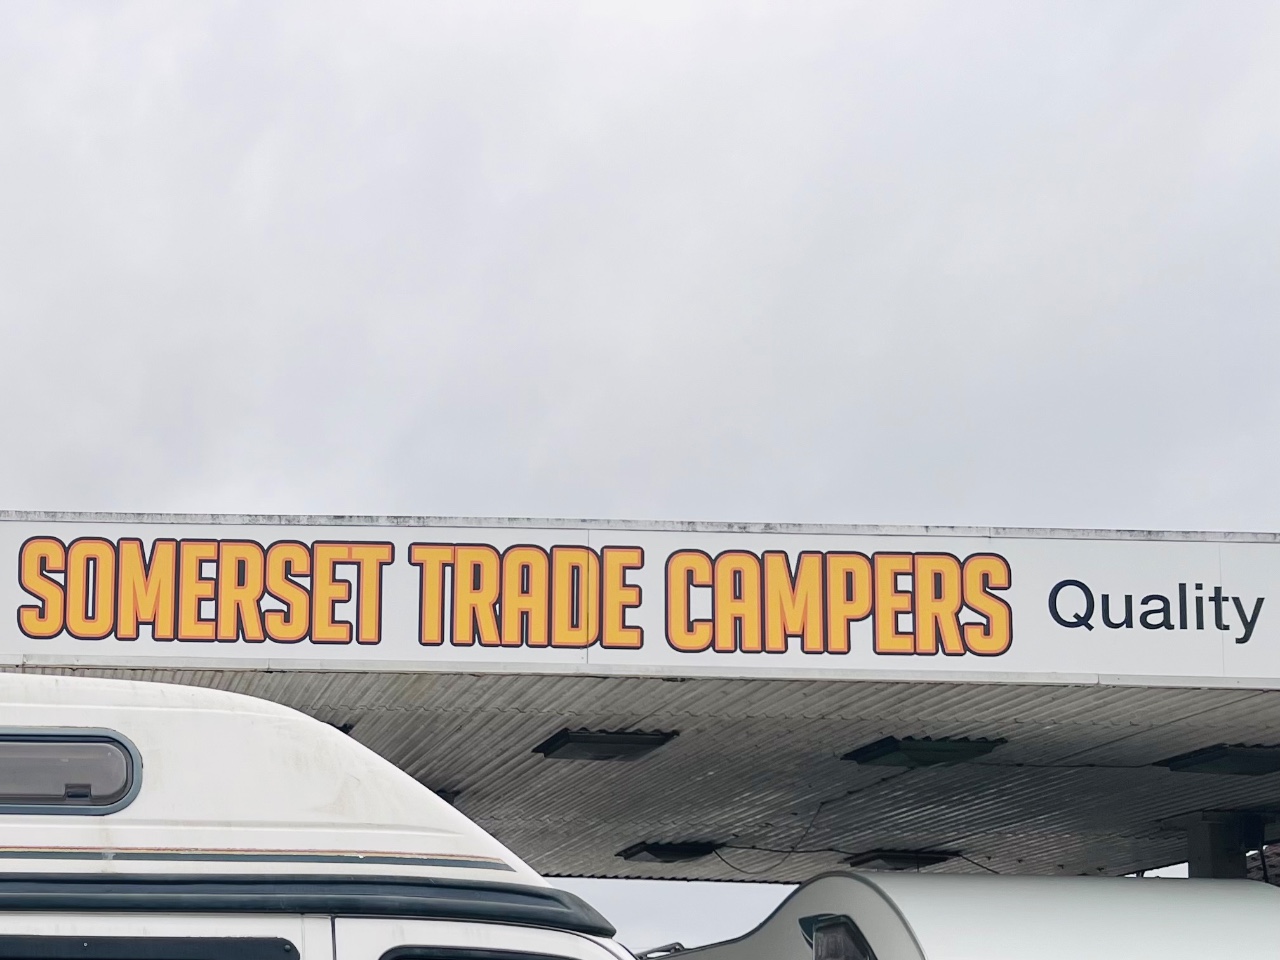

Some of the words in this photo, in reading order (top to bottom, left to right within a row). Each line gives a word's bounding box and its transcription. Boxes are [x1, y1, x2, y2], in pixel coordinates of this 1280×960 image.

[17, 535, 395, 645] SOMERSET
[410, 542, 645, 649] TRADE
[665, 549, 1013, 657] CAMPERS
[1048, 579, 1265, 644] Quality
